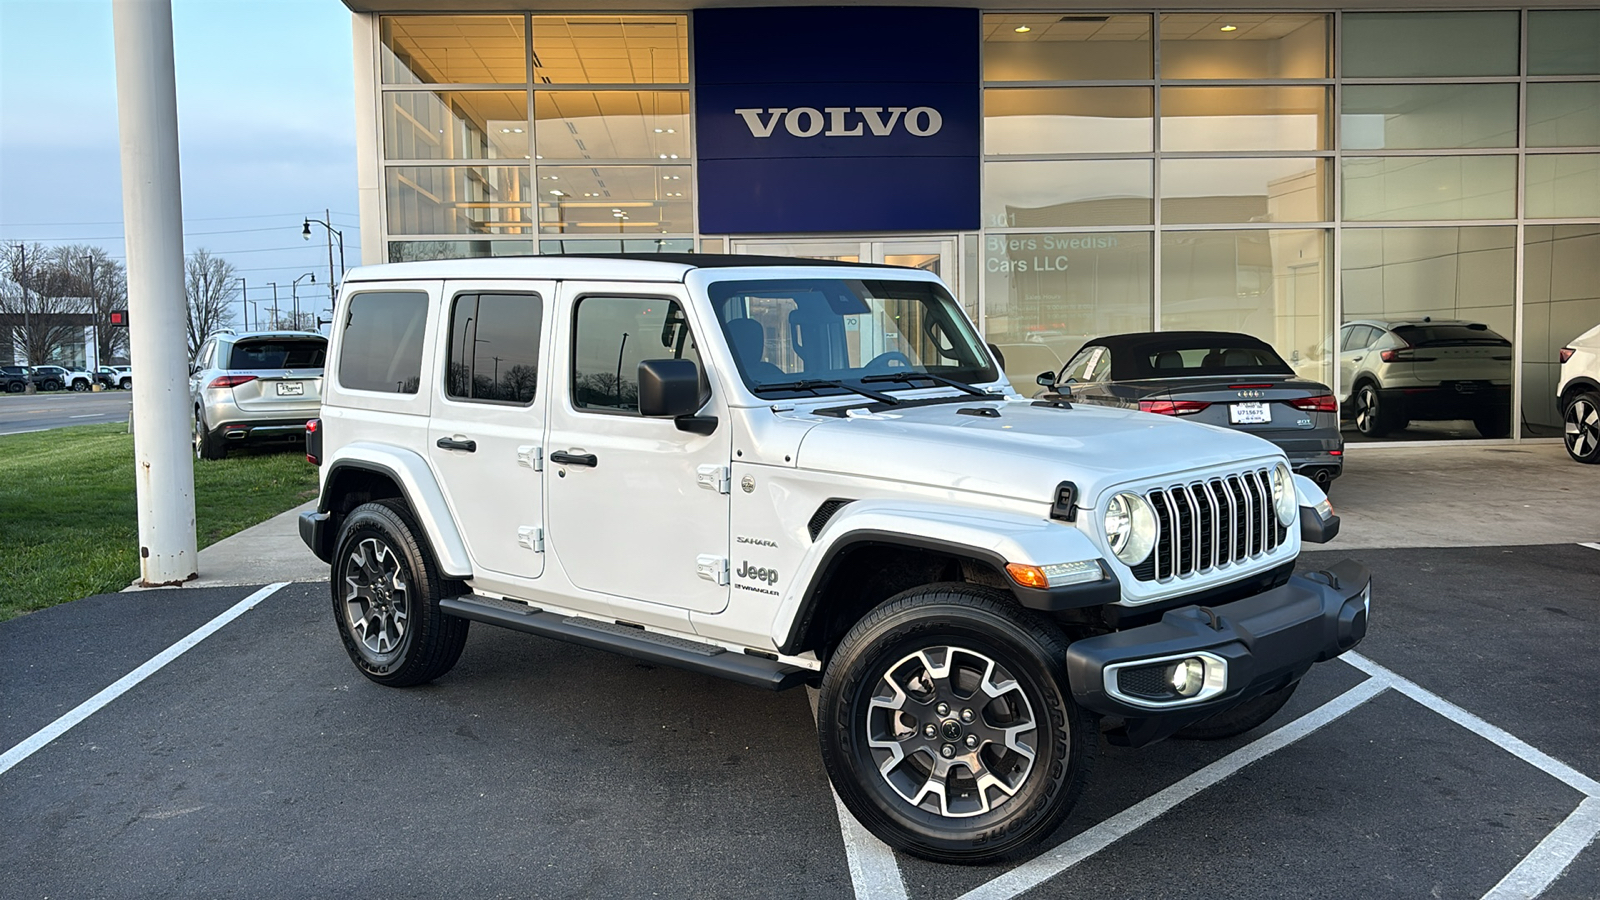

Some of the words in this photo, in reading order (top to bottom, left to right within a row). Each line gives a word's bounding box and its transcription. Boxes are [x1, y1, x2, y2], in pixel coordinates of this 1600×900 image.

[735, 106, 942, 138] VOLVO
[988, 212, 1016, 227] 301
[986, 236, 1037, 255] Byers
[1043, 235, 1118, 250] Swedish
[986, 257, 1028, 273] Cars
[1033, 255, 1069, 272] LLC
[846, 318, 857, 326] 70
[736, 536, 778, 548] SAHARA
[736, 560, 779, 586] Jeep
[741, 584, 779, 596] WRANGLER
[972, 686, 1067, 846] BRIDGESTONE
